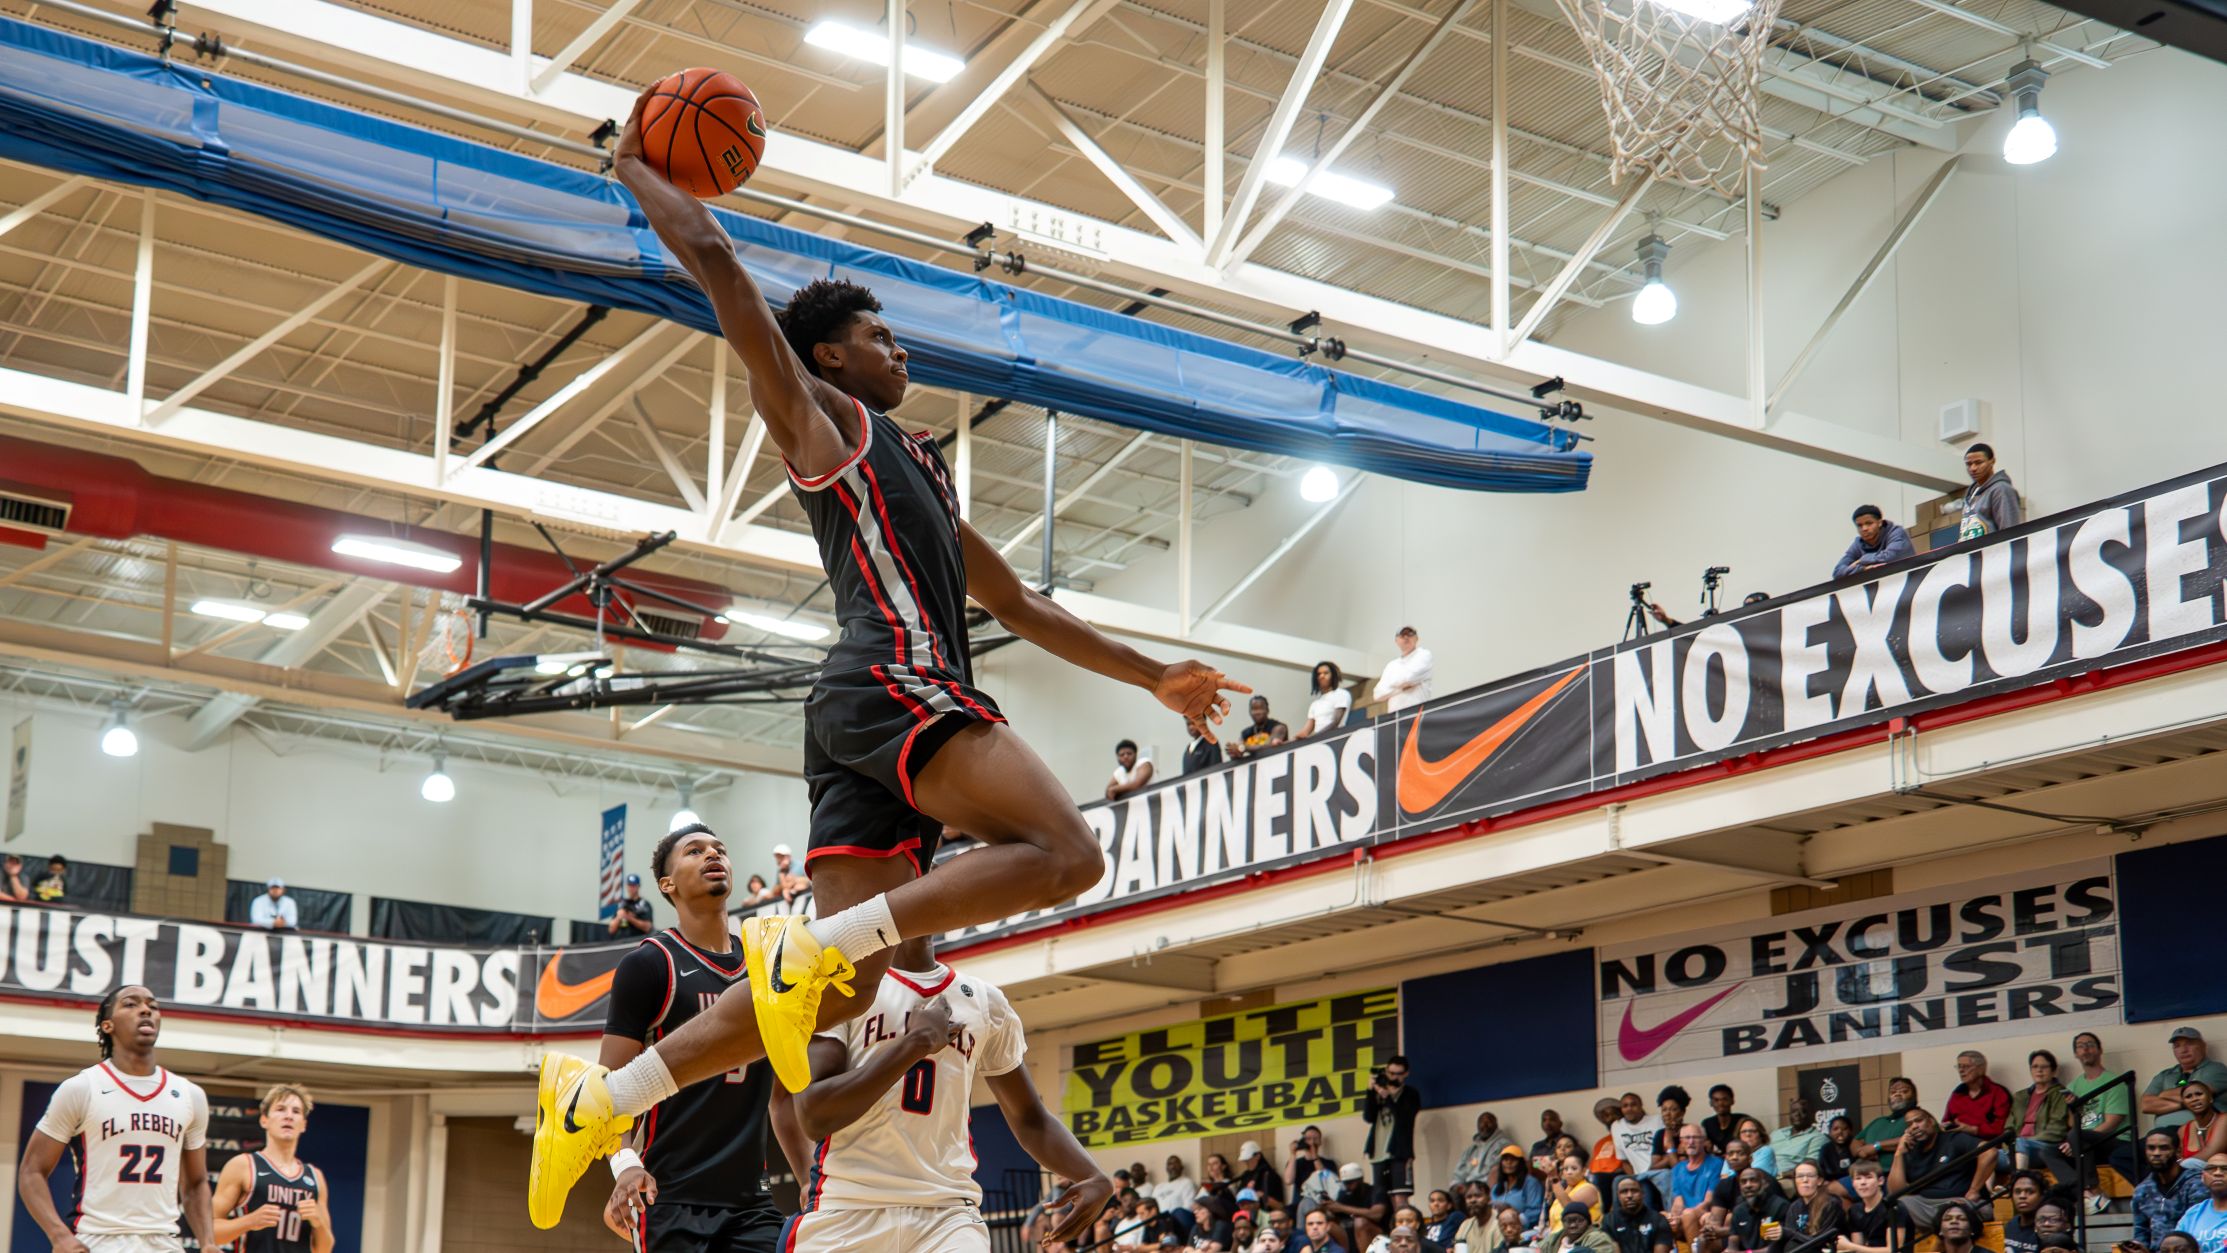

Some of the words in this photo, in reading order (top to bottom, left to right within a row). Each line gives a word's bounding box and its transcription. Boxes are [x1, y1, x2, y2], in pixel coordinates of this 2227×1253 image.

[1614, 622, 1751, 774] NO
[1781, 480, 2227, 732] EXCUSE
[1601, 944, 1727, 999] NO
[1751, 876, 2115, 977] EXCUSES
[173, 924, 520, 1027] BANNERS
[1763, 924, 2116, 1019] JUST
[864, 1013, 897, 1049] FL.
[1073, 988, 1398, 1067] ELITE
[1722, 975, 2120, 1057] BANNERS
[901, 1058, 936, 1116] 0
[1074, 1015, 1398, 1108] YOUTH
[102, 1118, 125, 1141] FL.
[1072, 1072, 1368, 1135] BASKETBAL
[1076, 1097, 1366, 1147] LEAGU
[118, 1144, 165, 1184] 22
[267, 1184, 314, 1206] UNITY
[276, 1208, 300, 1242] 10
